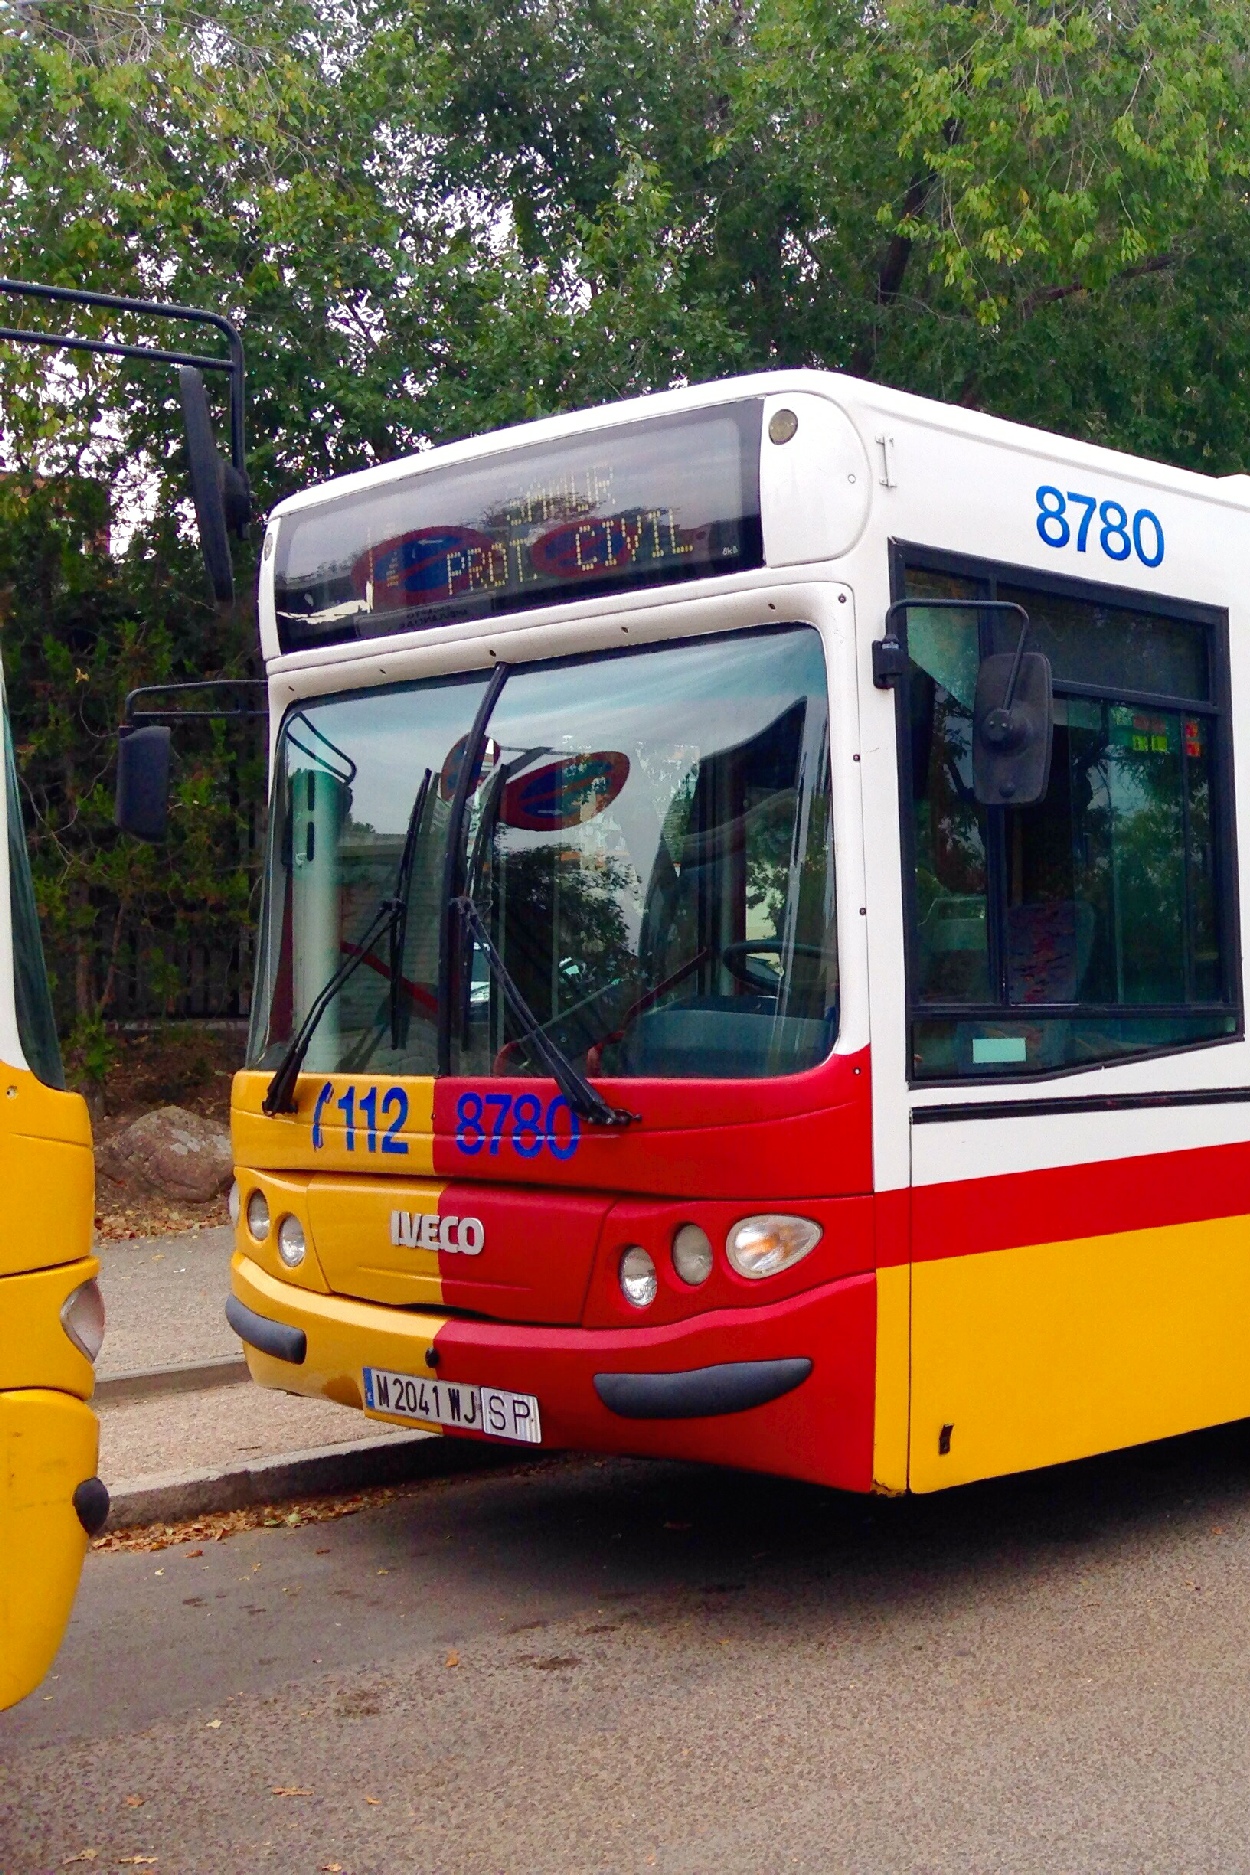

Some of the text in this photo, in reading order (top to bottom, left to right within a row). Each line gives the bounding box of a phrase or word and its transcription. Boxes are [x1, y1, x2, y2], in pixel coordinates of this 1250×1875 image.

[576, 508, 694, 571] CIVIL
[1036, 485, 1165, 568] 8780
[338, 1086, 409, 1154] 112
[455, 1091, 581, 1161] 8780
[390, 1210, 485, 1255] IVECO
[376, 1374, 477, 1424] M 2041 WJ
